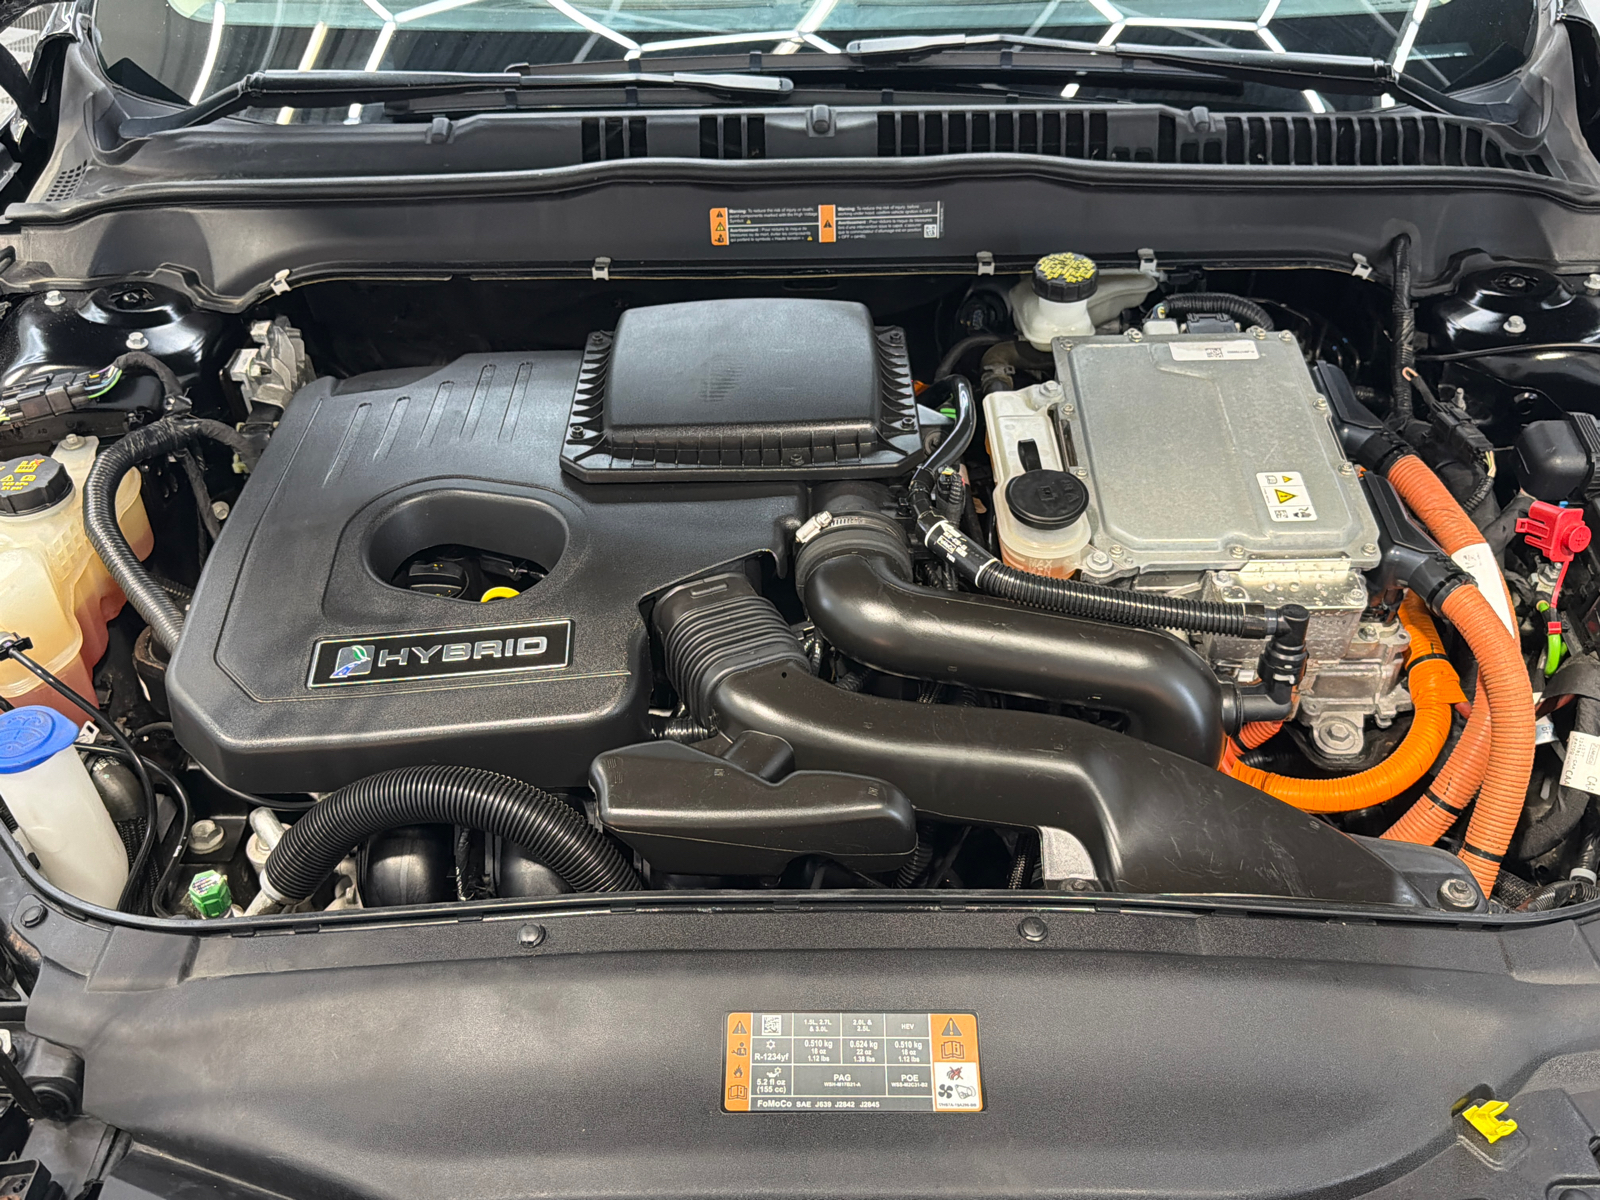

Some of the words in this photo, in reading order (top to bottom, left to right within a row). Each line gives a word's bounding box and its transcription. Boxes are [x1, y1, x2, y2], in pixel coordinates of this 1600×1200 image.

[378, 636, 548, 667] HYBRID
[804, 1039, 823, 1048] 0.510
[823, 1039, 833, 1049] kg
[849, 1040, 868, 1048] 0.624
[869, 1040, 878, 1050] kg
[894, 1040, 913, 1049] 0.510
[914, 1041, 923, 1050] kg
[754, 1052, 789, 1062] R-1234yf
[866, 1055, 876, 1063] lbs
[756, 1078, 768, 1086] 5.2
[769, 1078, 775, 1086] fl
[833, 1074, 851, 1082] PAG
[900, 1074, 919, 1082] POE
[756, 1085, 773, 1094] (155
[774, 1086, 787, 1094] cc)
[757, 1100, 793, 1108] FoMoCo
